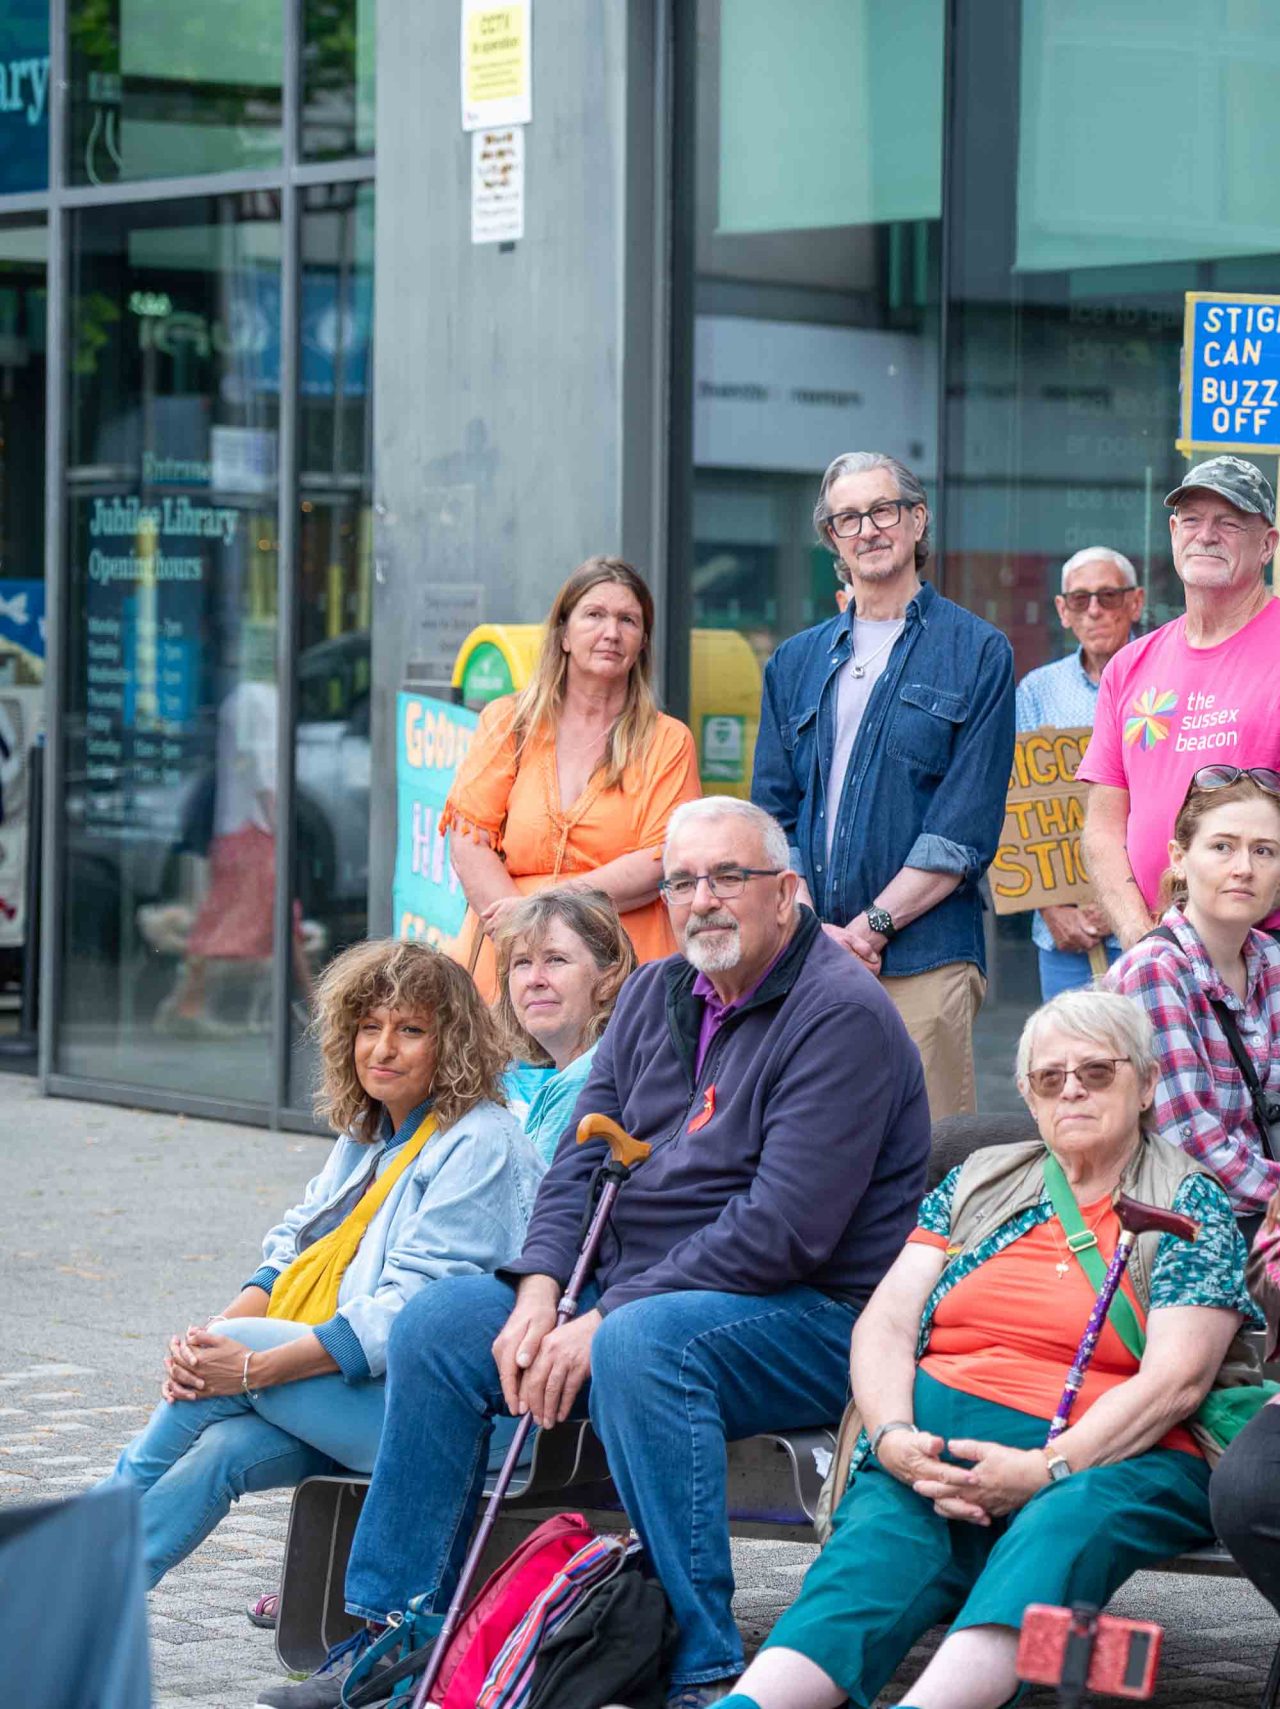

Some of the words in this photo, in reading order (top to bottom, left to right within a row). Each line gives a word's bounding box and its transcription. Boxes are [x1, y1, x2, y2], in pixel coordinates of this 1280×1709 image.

[1203, 338, 1262, 367] CAN
[1201, 377, 1279, 407] BUZZ
[1212, 407, 1271, 435] OFF
[90, 496, 159, 536] Jubilee
[162, 496, 239, 546] Library
[1187, 692, 1216, 711] the
[1181, 708, 1240, 730] sussex
[1175, 731, 1238, 752] beacon
[1008, 735, 1091, 789] IGG
[411, 802, 460, 894] HI
